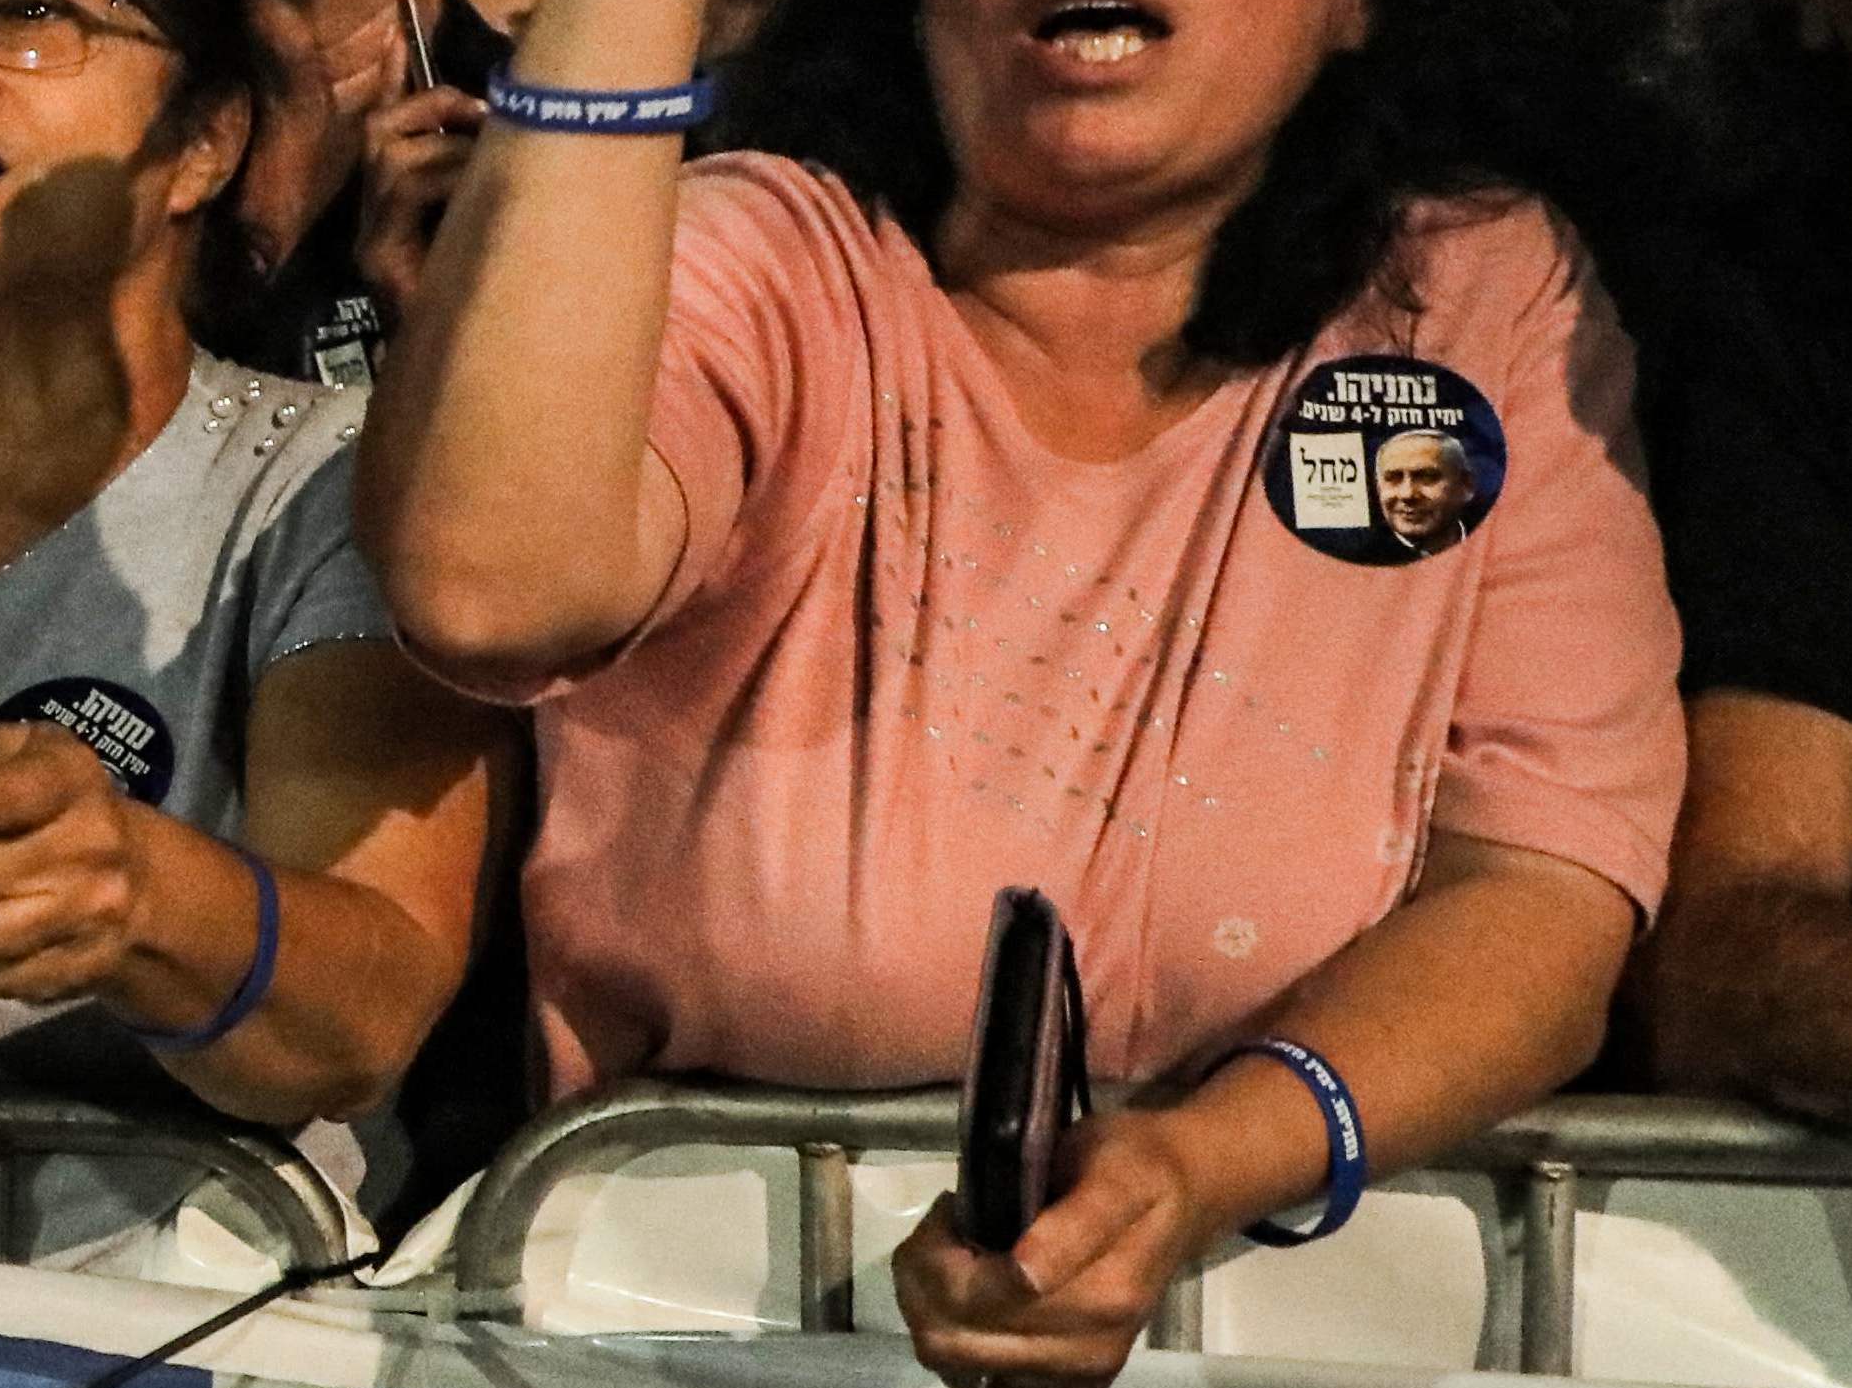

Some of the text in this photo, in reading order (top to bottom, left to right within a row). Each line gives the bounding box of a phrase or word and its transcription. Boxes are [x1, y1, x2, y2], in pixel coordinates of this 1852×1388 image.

[1327, 372, 1437, 405] נתניהו.
[1387, 407, 1424, 427] חזק
[1428, 408, 1464, 428] ימין
[1299, 446, 1358, 485] מחל
[72, 687, 156, 751] נתניהו.
